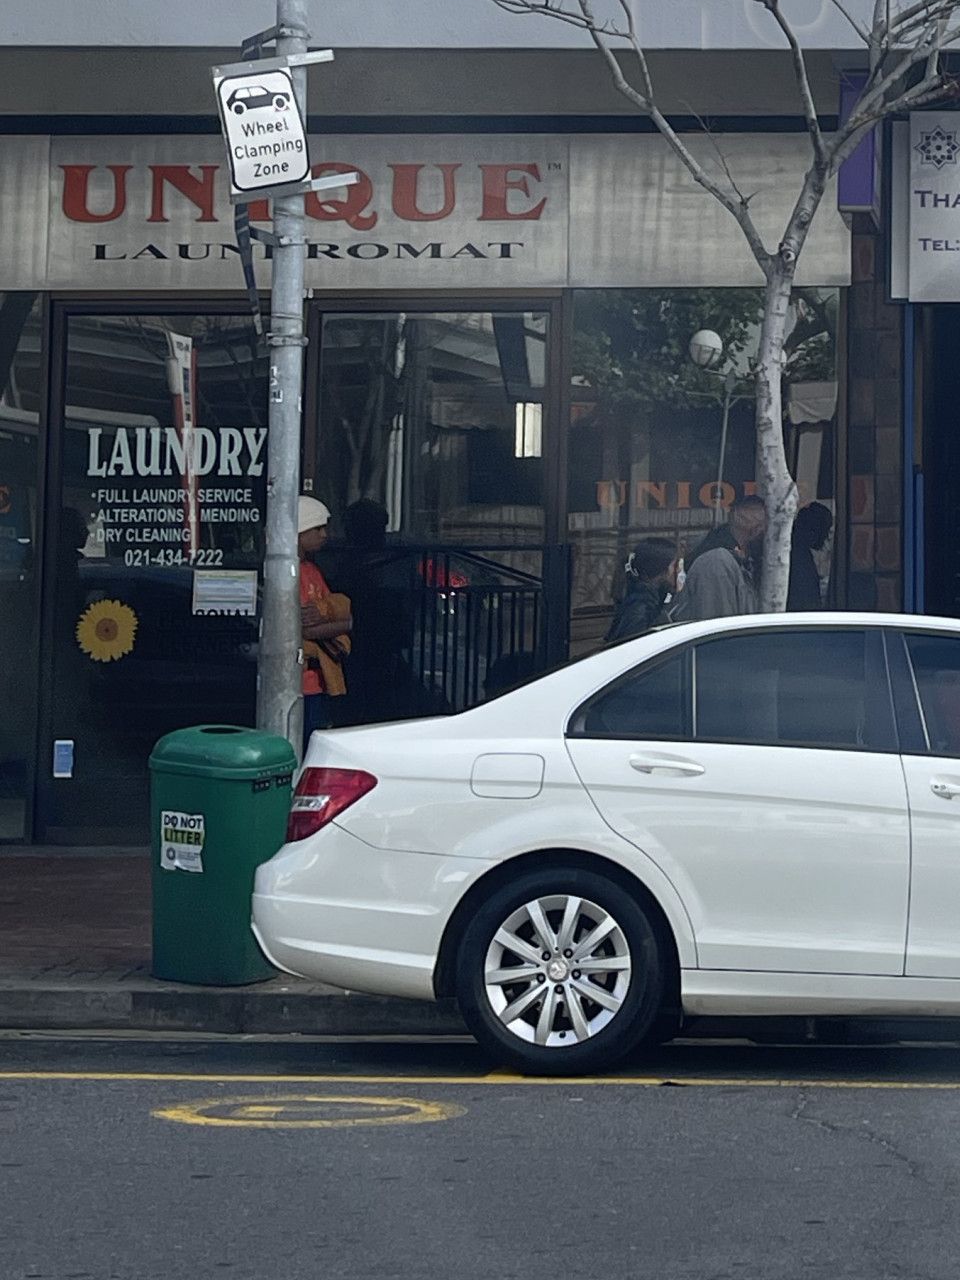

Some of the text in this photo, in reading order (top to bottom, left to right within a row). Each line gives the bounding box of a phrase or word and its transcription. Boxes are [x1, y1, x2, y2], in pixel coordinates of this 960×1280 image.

[241, 118, 290, 138] Wheel
[234, 136, 304, 160] Clamping
[253, 161, 290, 178] Zone
[94, 242, 525, 261] LAUNROMAT
[87, 427, 267, 477] LAUNDRY
[97, 489, 252, 503] FULL LAUNDRY SERVICE
[595, 481, 785, 510] UNIQ
[97, 509, 184, 523] ALTERATIONS
[200, 508, 260, 523] MENDING
[97, 528, 191, 542] DRY CLEANING
[124, 548, 223, 567] 021-434-7222
[164, 814, 202, 829] DO NOT
[164, 828, 202, 846] LITTER
